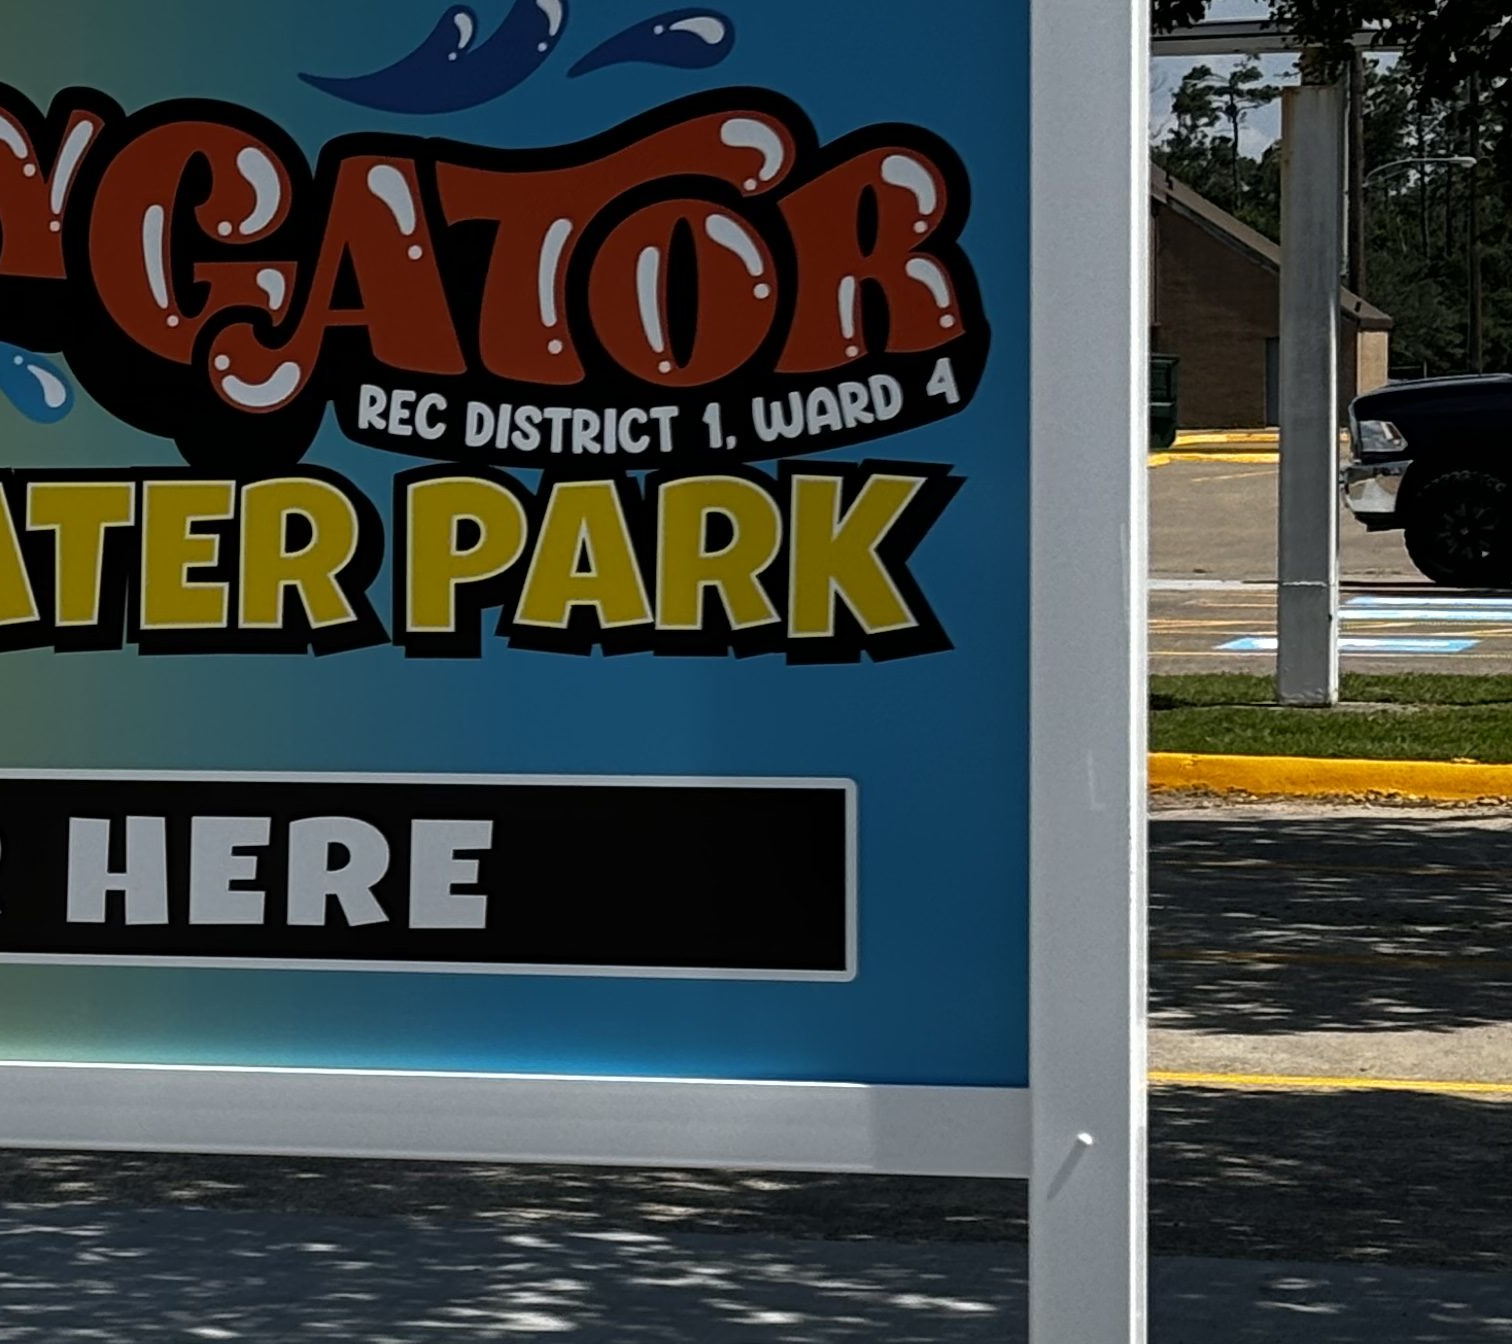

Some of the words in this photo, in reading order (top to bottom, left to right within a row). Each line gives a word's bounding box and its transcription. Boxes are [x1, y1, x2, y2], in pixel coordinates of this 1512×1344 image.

[89, 109, 966, 415] GATOR
[357, 383, 448, 441] REC
[463, 400, 680, 455] DISTRICT
[701, 401, 738, 451] 1,
[751, 372, 903, 443] WARD
[925, 356, 961, 405] 4
[405, 473, 928, 639] PARK
[65, 815, 494, 930] HERE
